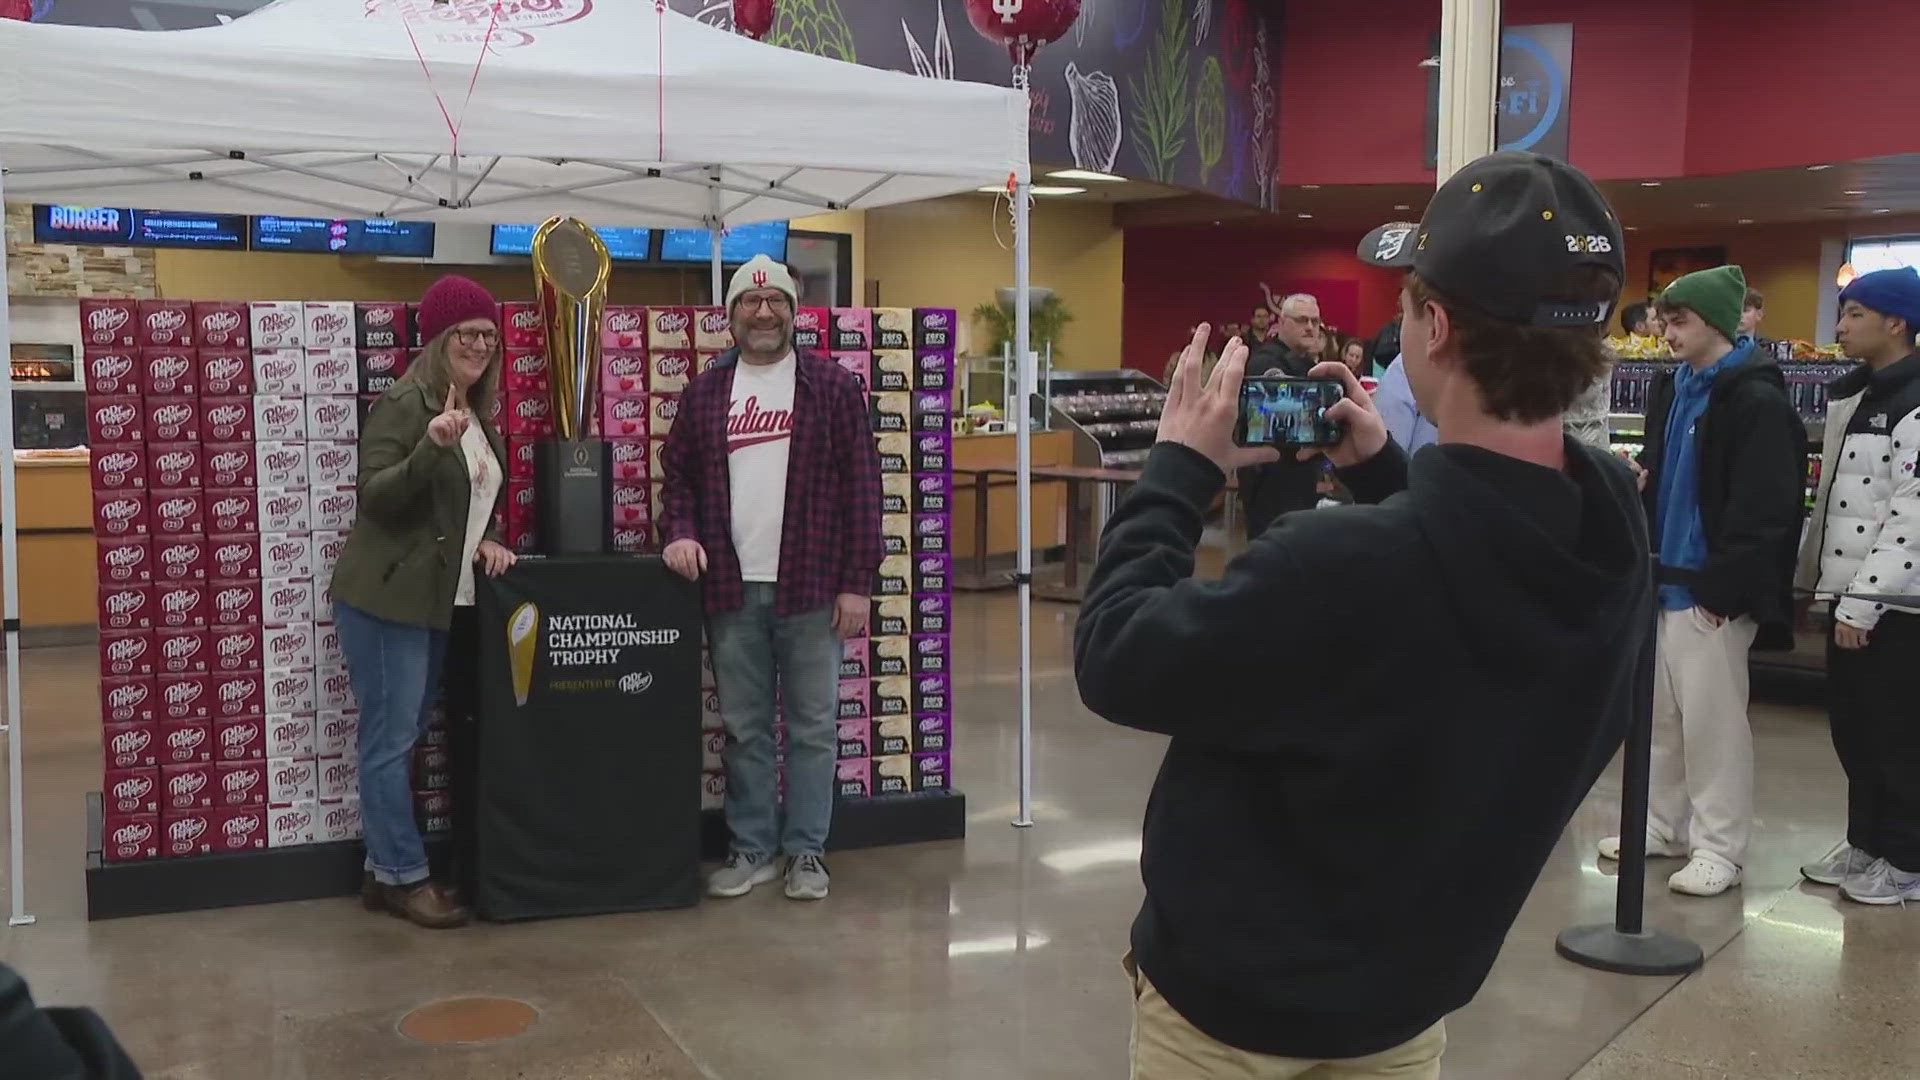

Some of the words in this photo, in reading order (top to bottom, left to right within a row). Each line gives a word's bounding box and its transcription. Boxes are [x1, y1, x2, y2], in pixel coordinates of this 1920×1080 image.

[51, 206, 119, 231] BURGER
[366, 332, 394, 342] zero
[549, 614, 638, 631] NATIONAL
[549, 629, 680, 648] CHAMPIONSHIP
[549, 648, 621, 666] TROPHY
